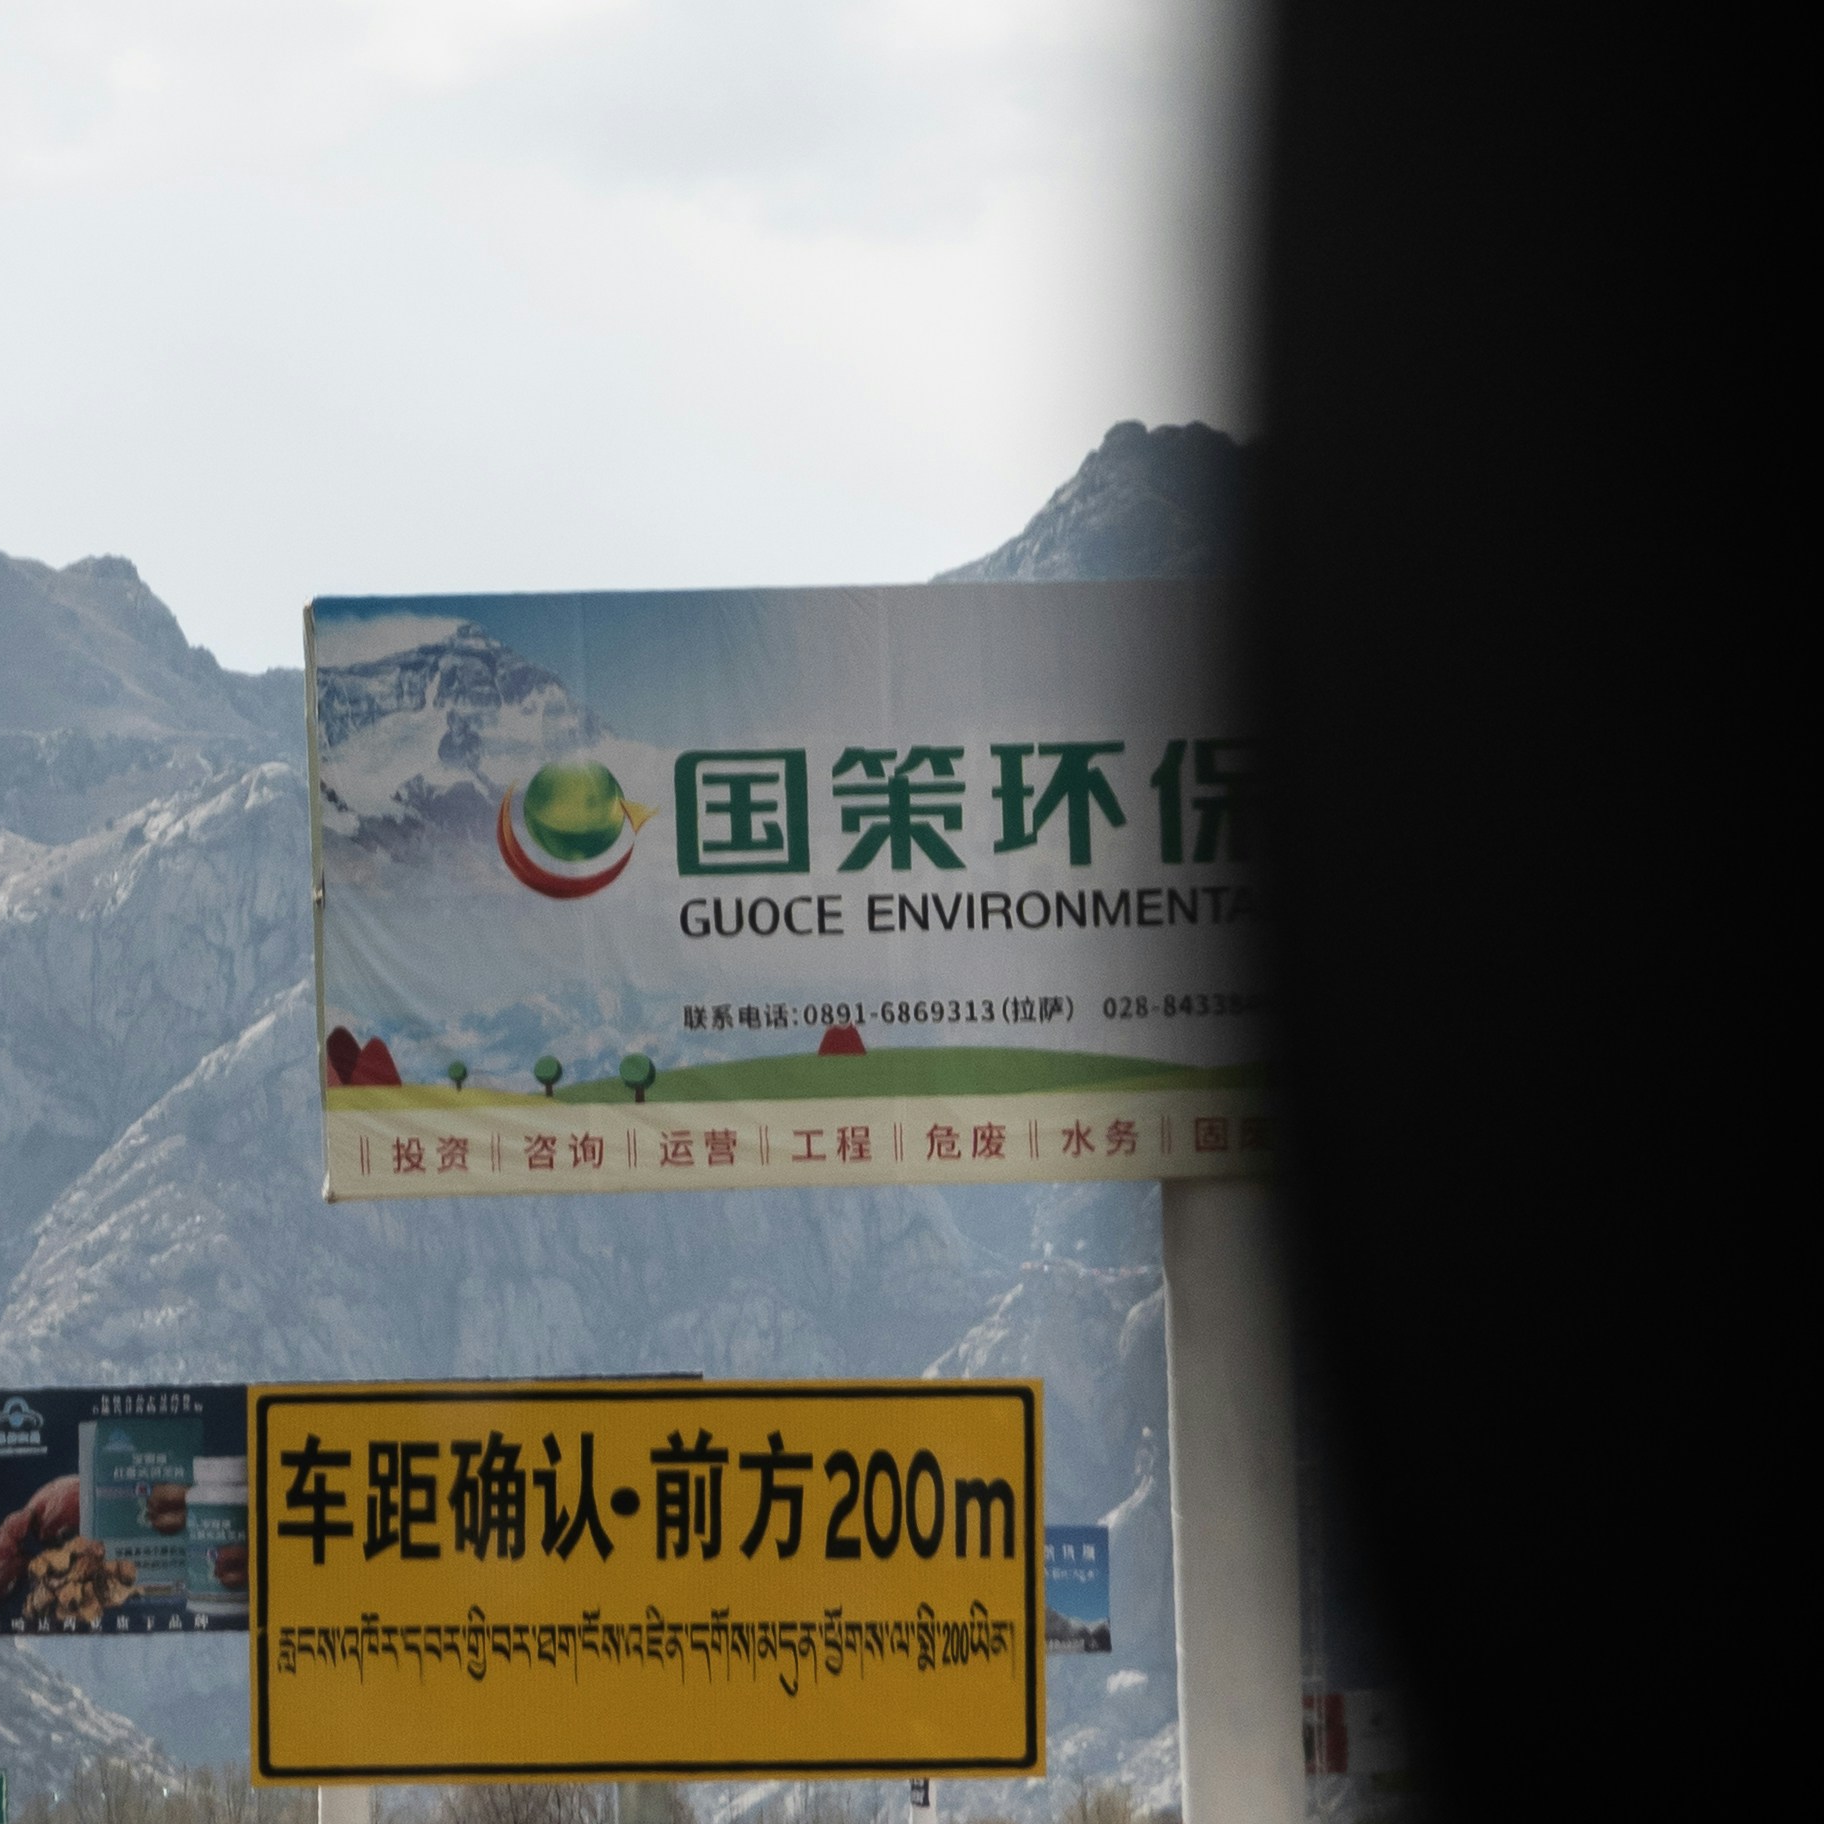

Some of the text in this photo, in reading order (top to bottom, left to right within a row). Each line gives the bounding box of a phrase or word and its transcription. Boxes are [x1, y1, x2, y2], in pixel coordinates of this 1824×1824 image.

[674, 739, 1260, 877] 国策环保
[679, 894, 845, 938] GUOCE
[390, 1134, 472, 1176] 投资
[522, 1132, 607, 1172] 咨询
[658, 1128, 740, 1170] 运营
[790, 1124, 874, 1164] 工程
[924, 1122, 1008, 1162] 危废
[1060, 1118, 1142, 1158] 水务
